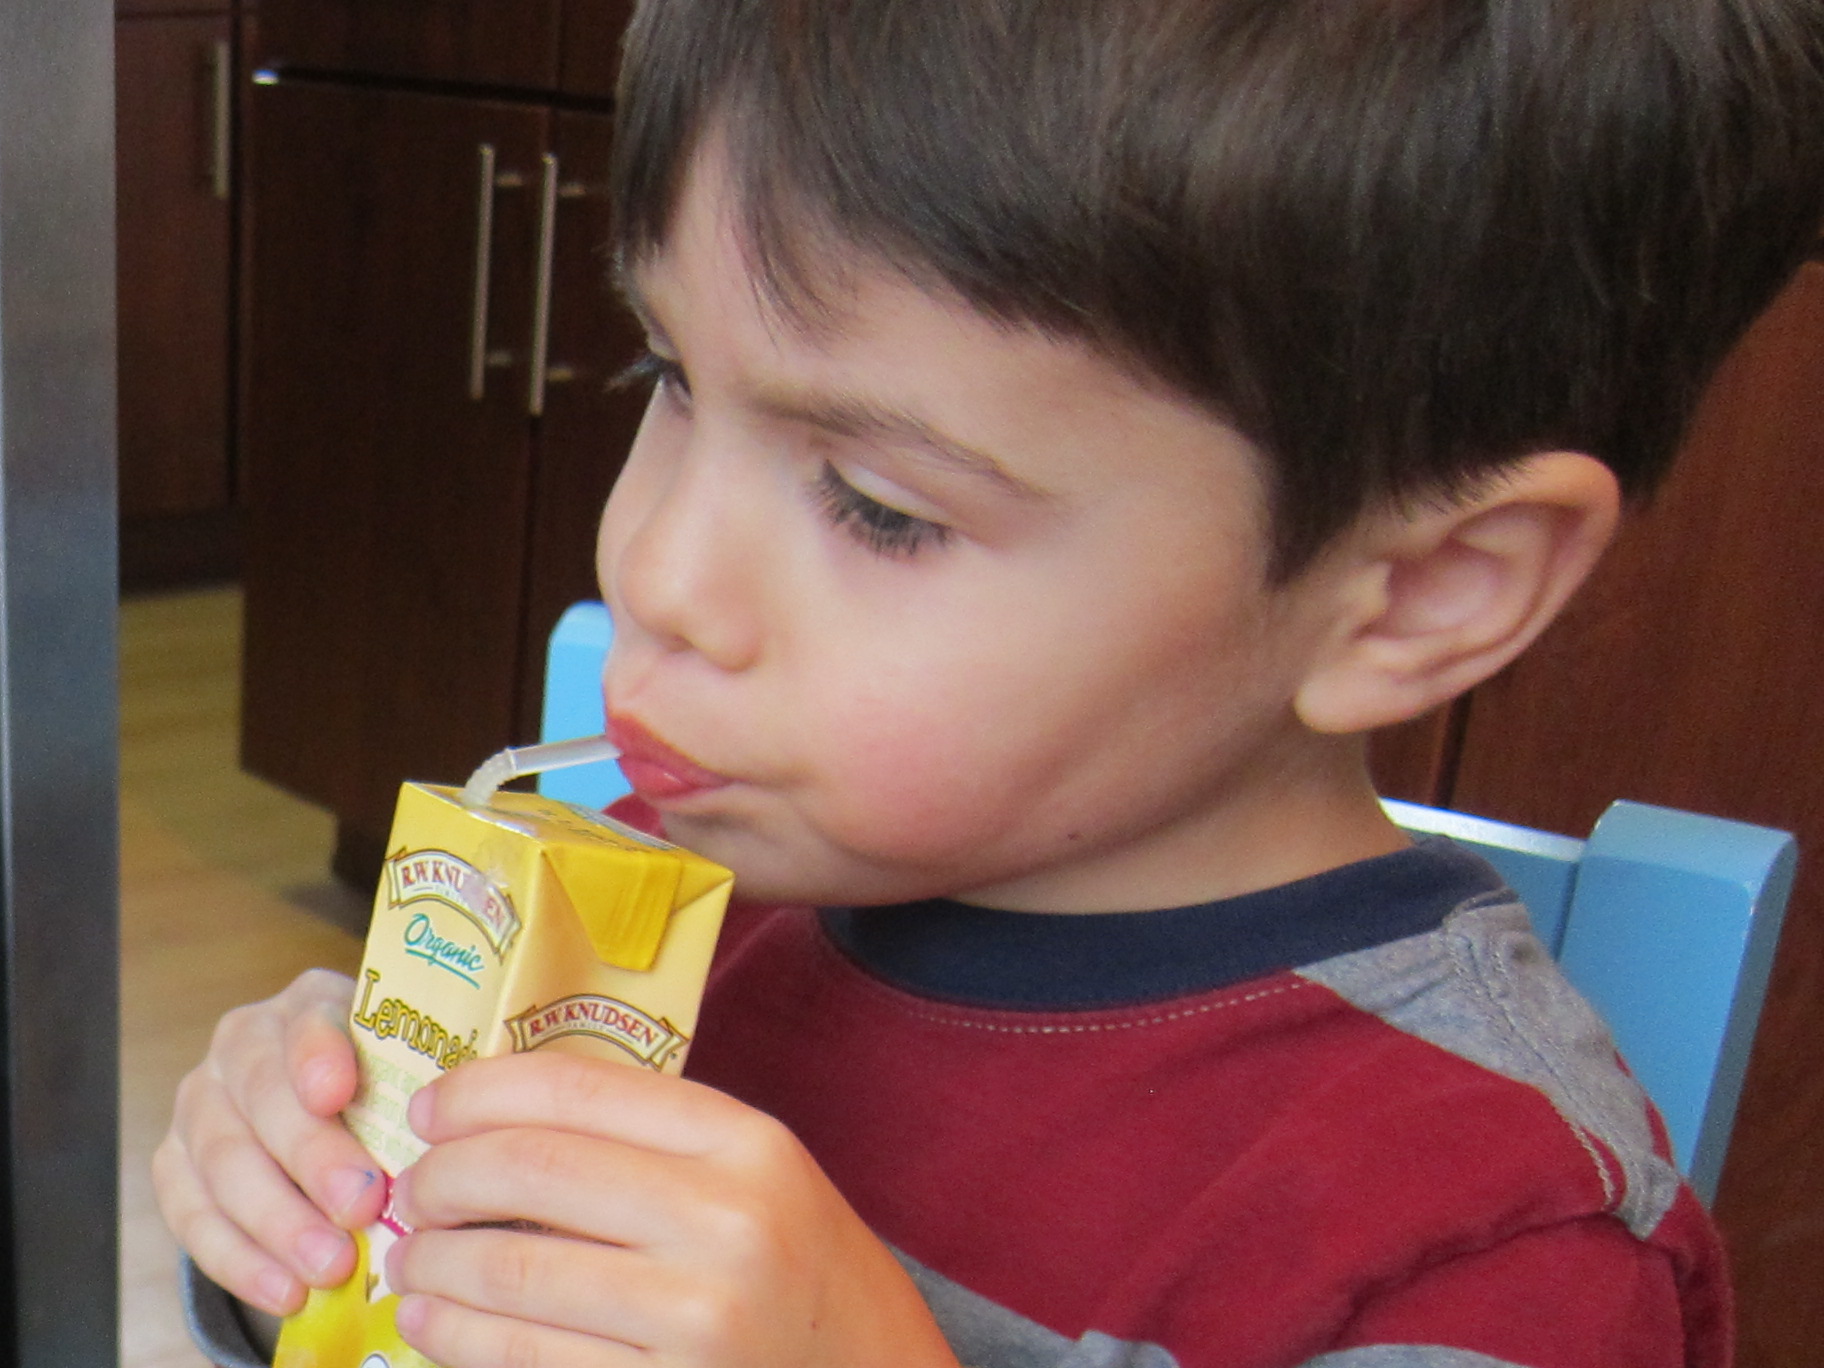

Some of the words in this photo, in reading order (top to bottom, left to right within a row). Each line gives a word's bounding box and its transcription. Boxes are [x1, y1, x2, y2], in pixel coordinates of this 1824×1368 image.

[432, 861, 504, 929] KNUEN
[404, 913, 484, 971] Organic
[564, 1003, 659, 1047] KNUDSEN
